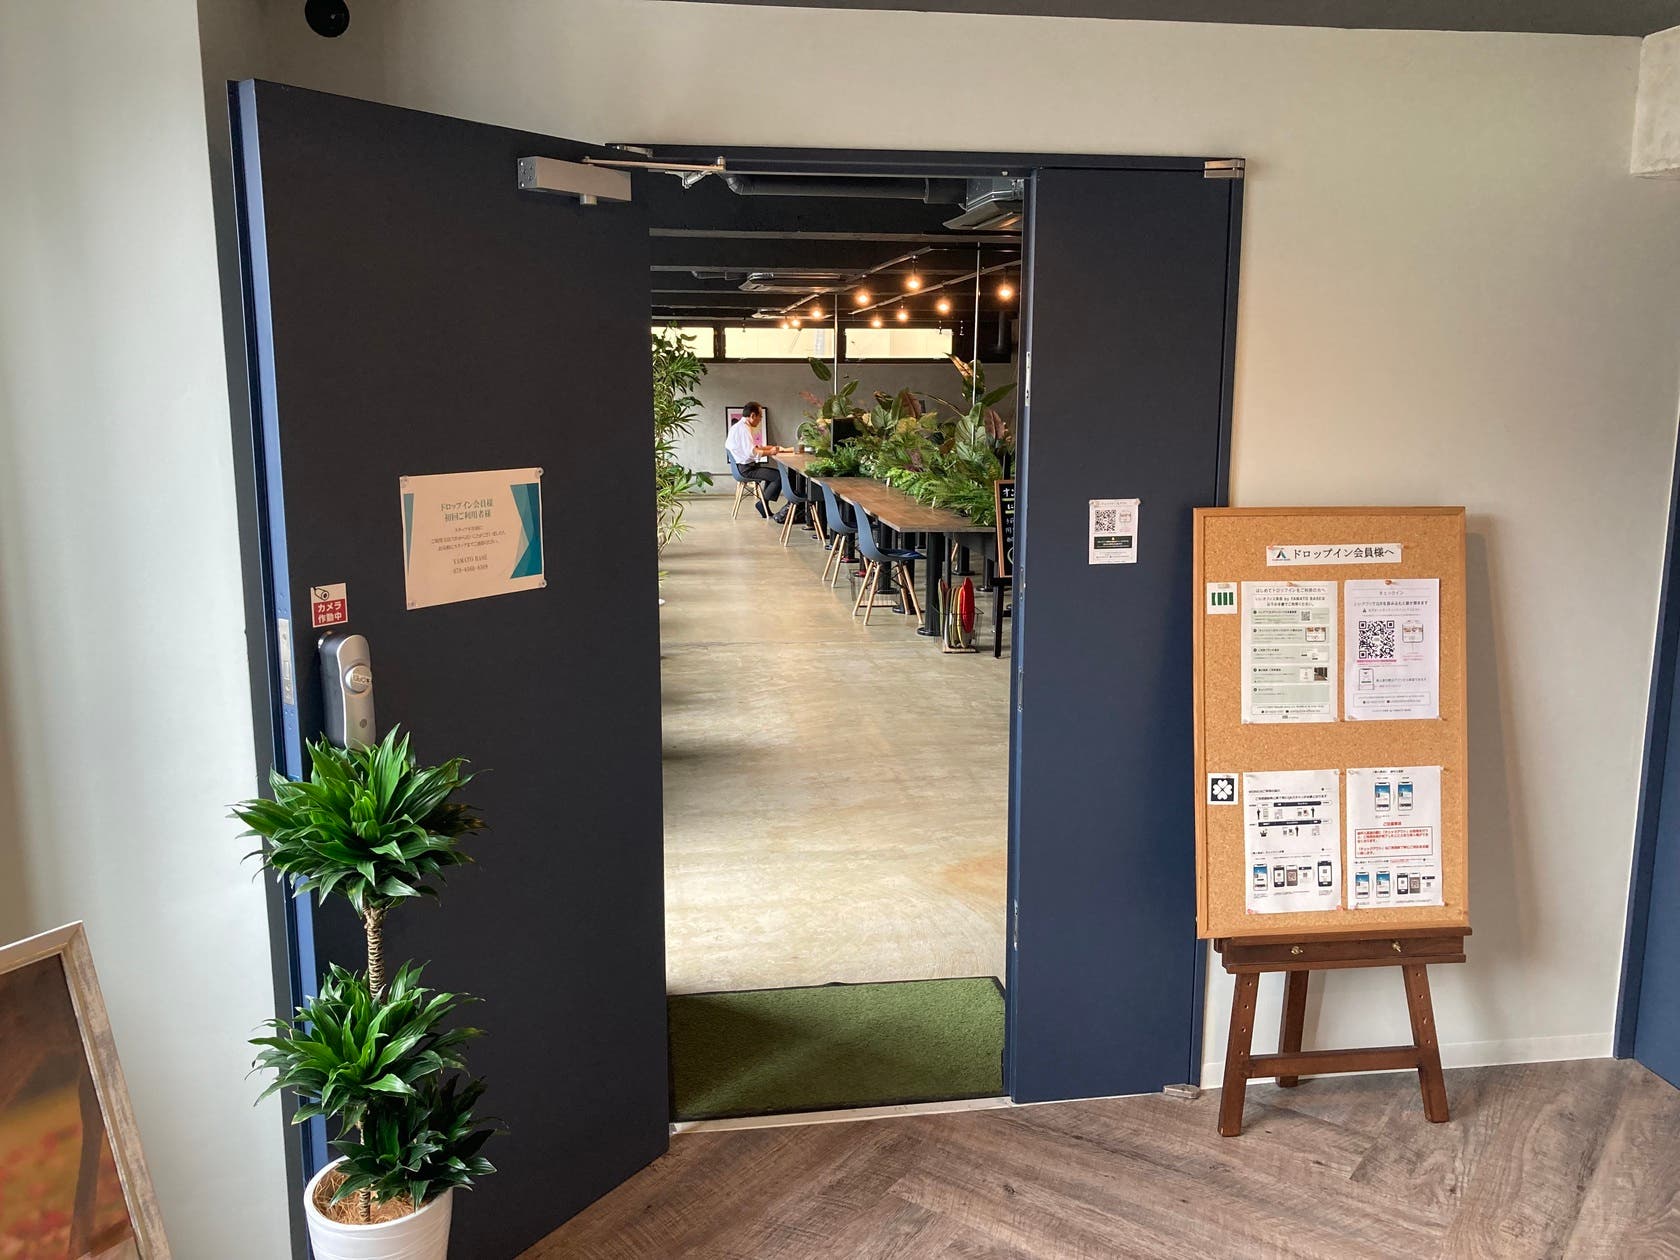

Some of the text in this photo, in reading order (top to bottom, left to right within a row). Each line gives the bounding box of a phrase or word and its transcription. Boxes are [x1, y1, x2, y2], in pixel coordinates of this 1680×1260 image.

[440, 498, 494, 511] ドロップイン会員様
[444, 509, 491, 522] 初回ご利用者様
[1294, 547, 1395, 560] ドロップイン会員様へ
[318, 601, 342, 613] カメラ
[318, 612, 342, 624] 作動中
